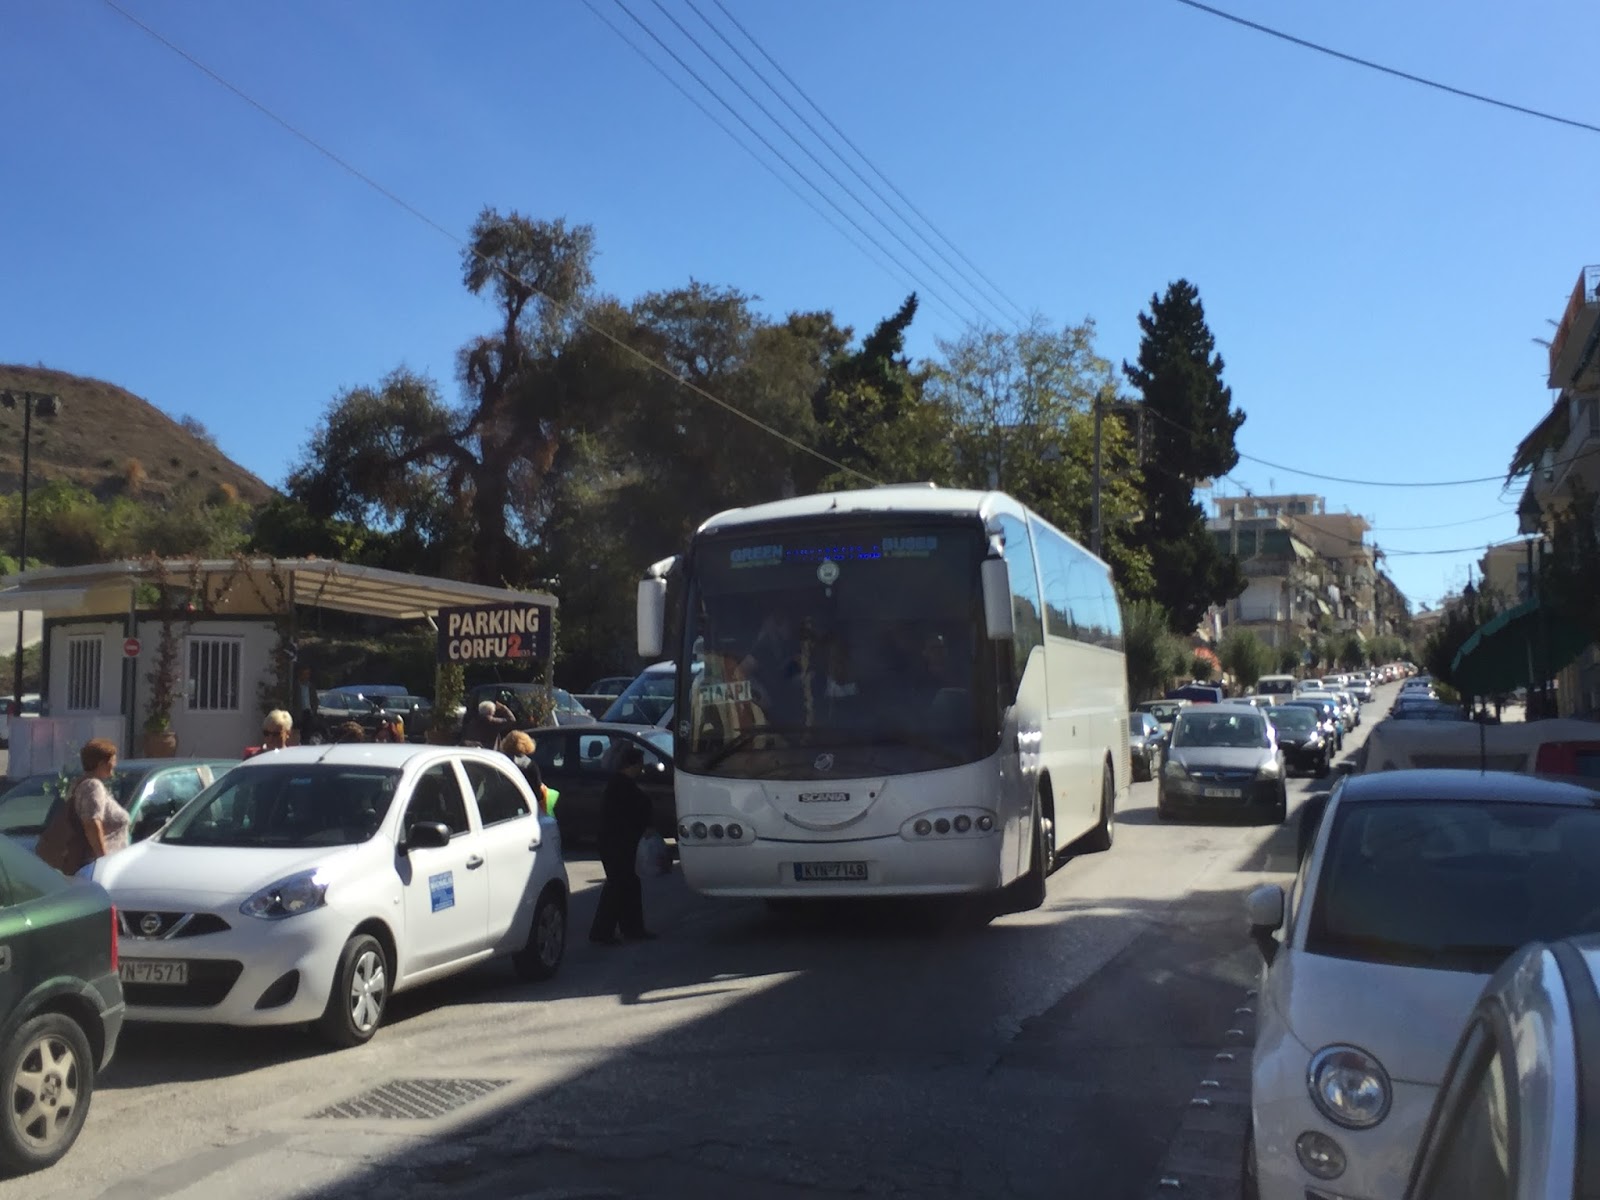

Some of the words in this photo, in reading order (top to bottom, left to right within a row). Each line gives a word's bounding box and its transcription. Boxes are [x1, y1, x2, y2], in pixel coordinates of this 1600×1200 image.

[449, 607, 539, 637] PARKING
[448, 637, 507, 660] CORFU
[801, 792, 847, 802] SCANIA
